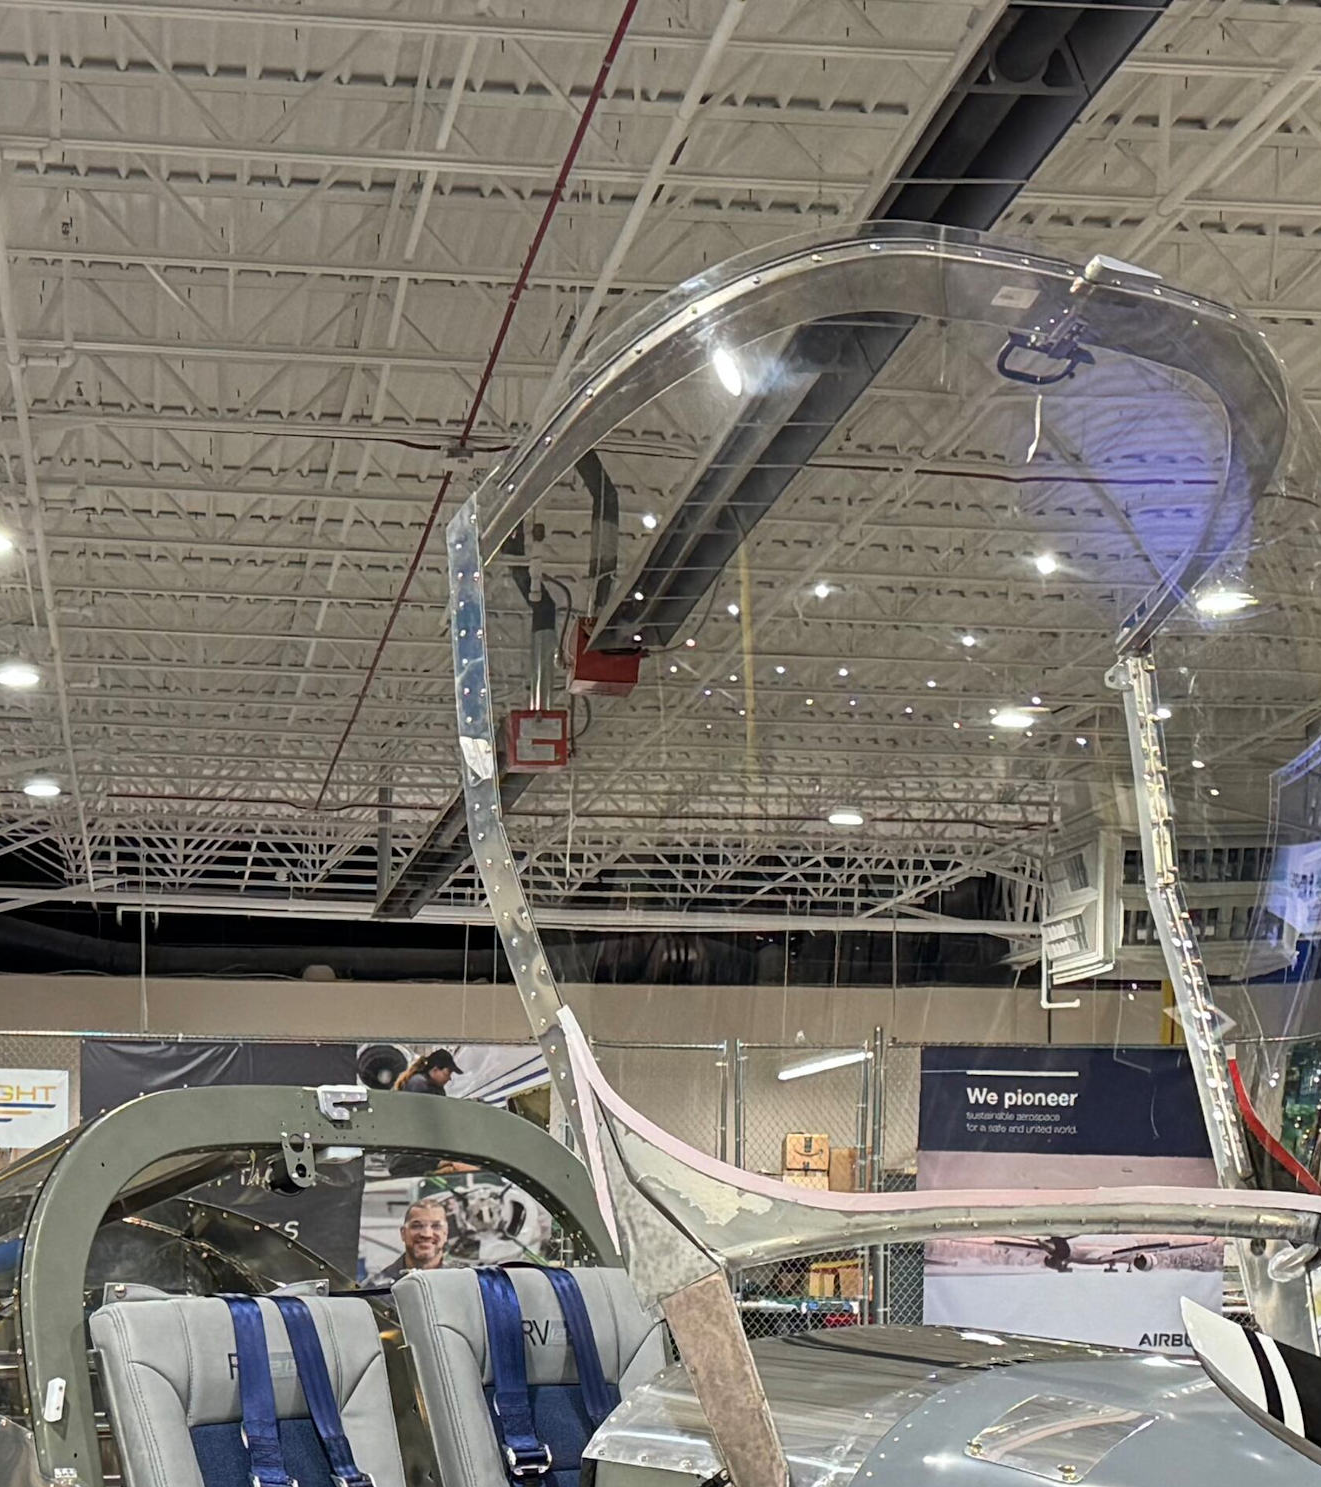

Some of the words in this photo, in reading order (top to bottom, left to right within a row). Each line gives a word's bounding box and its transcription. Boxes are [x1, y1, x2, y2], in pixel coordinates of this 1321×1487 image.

[966, 1087, 999, 1105] We
[1003, 1088, 1078, 1109] pioneer
[1138, 1332, 1194, 1347] AIRBU
